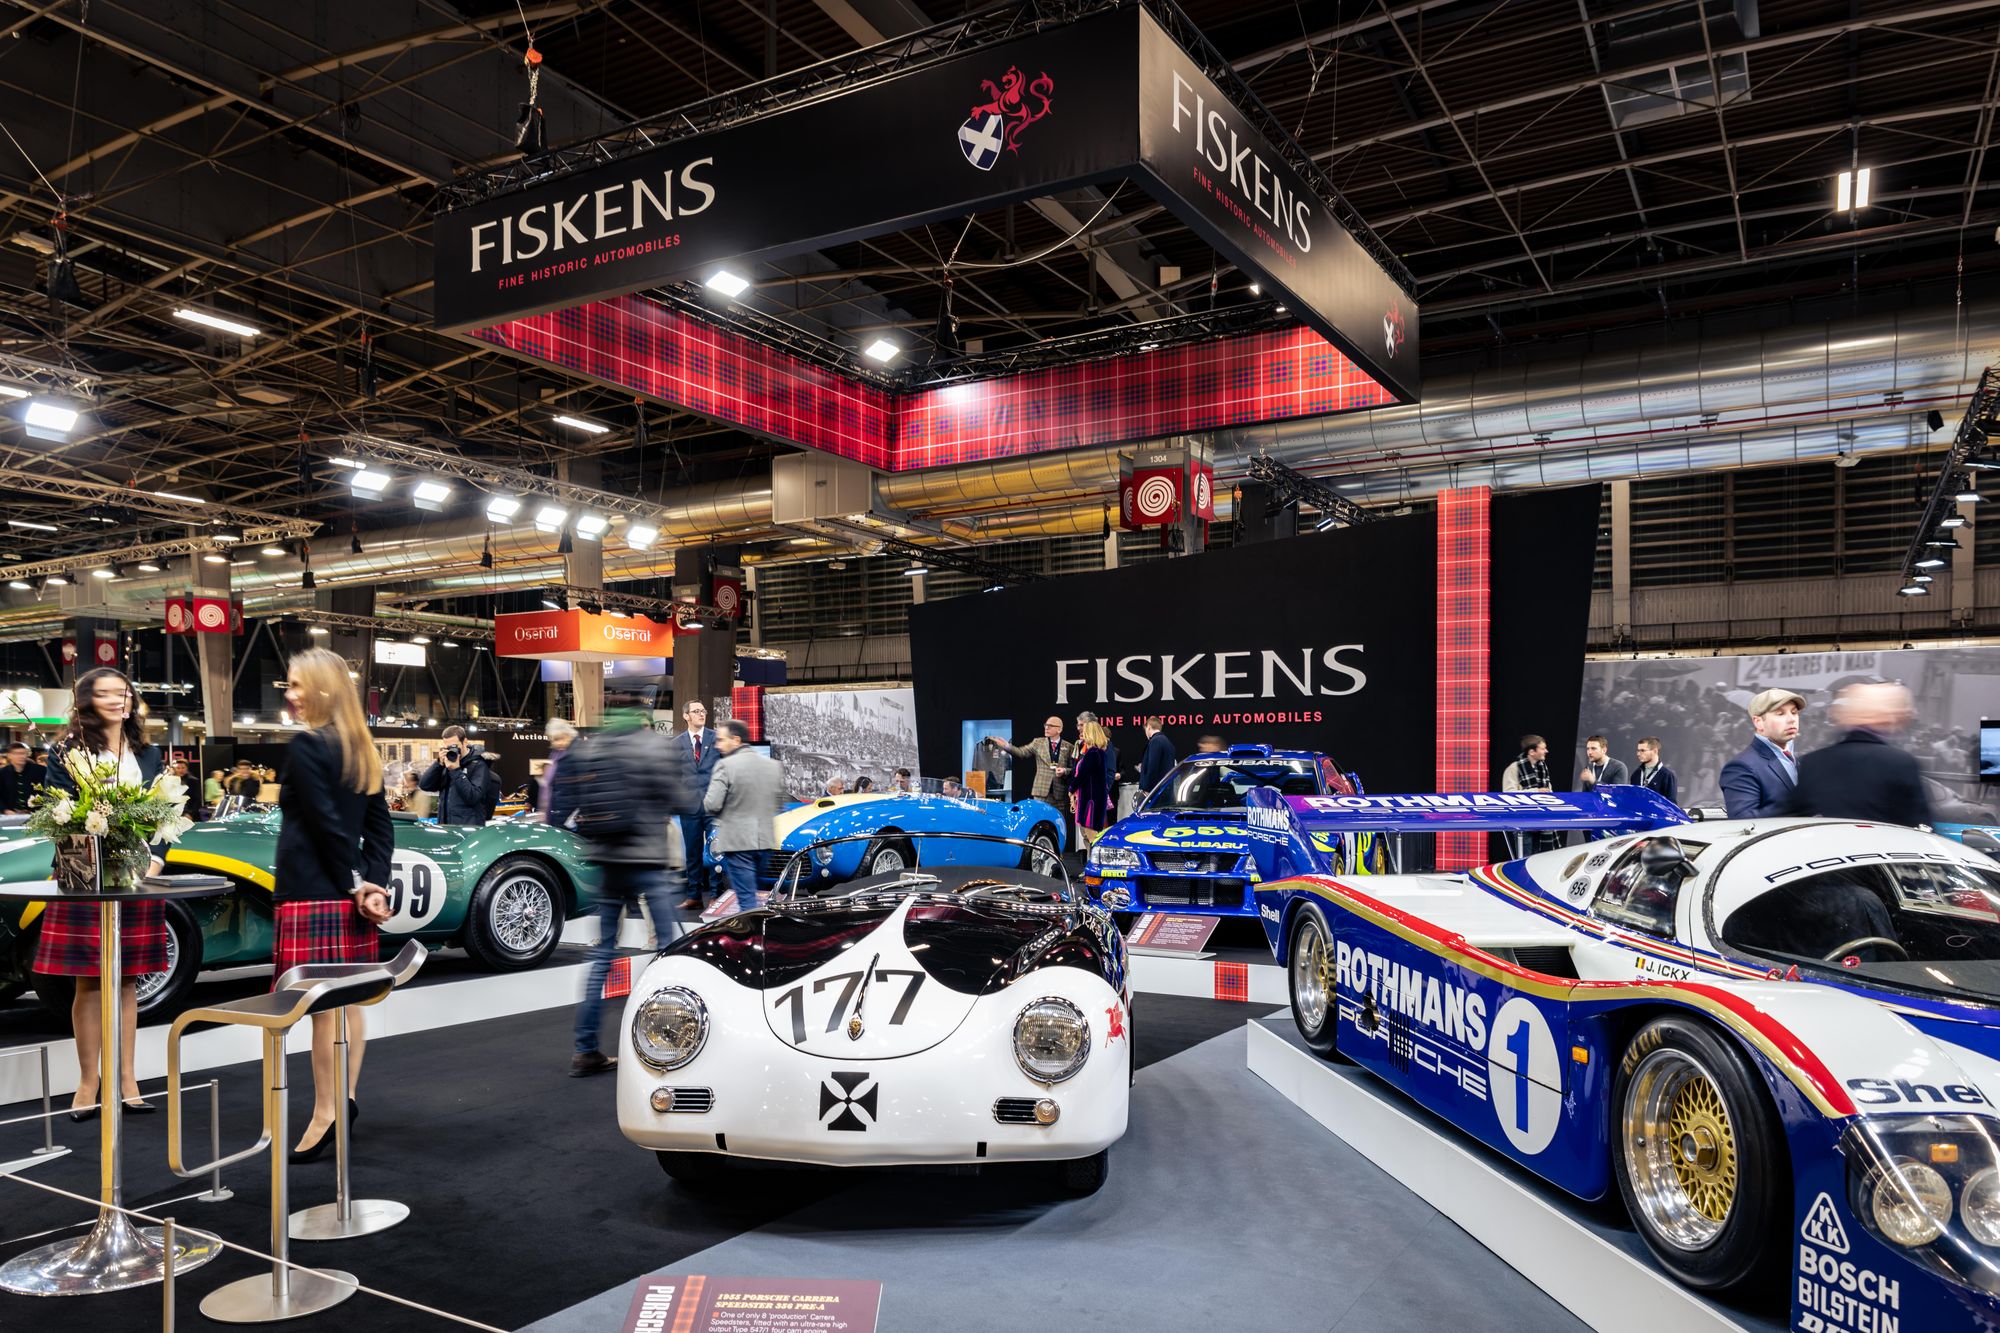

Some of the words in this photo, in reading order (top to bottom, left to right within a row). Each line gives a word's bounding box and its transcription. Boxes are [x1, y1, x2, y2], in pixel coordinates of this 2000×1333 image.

[1172, 69, 1311, 253] FISKENS
[470, 156, 716, 273] FISKENS
[1193, 166, 1212, 192] FINE
[1215, 187, 1251, 228] HISTORIC
[1253, 223, 1297, 269] AUTOMOBILES
[498, 275, 525, 290] FINE
[531, 257, 588, 282] HISTORIC
[593, 234, 681, 265] AUTOMOBILES
[1149, 455, 1167, 463] 1304
[514, 625, 558, 642] Osenat
[603, 624, 652, 642] Osenat
[1055, 644, 1367, 704] FISKENS
[1100, 716, 1124, 727] INE
[1133, 714, 1204, 727] HITORIC
[1212, 711, 1323, 725] AUTOMOBILES
[1303, 794, 1566, 808] ROTHMANS
[1247, 806, 1290, 831] ROTHMANS
[1180, 841, 1249, 850] SUBARU
[1247, 831, 1289, 846] PORSCHE
[1589, 855, 1609, 867] 956
[1569, 881, 1588, 897] 956
[1260, 903, 1280, 924] Shell
[1336, 940, 1487, 1051] ROTHMANS
[774, 969, 927, 1046] 177
[1338, 1003, 1487, 1101] PORSCHE
[1622, 1025, 1663, 1076] AVON
[1506, 1019, 1530, 1134] 1
[1799, 1243, 1900, 1311] BOSCH
[714, 1301, 774, 1309] SPEEDSTER
[794, 1302, 825, 1311] PRE-A
[742, 1293, 791, 1302] PORSCHE
[791, 1295, 840, 1303] CARRERA
[1798, 1275, 1900, 1333] BILSTEIN
[720, 1311, 736, 1319] One
[736, 1311, 745, 1319] of
[745, 1312, 761, 1321] only
[810, 1313, 835, 1321] Carrera
[753, 1319, 772, 1327] fitted
[800, 1320, 831, 1328] ultra-rare
[832, 1321, 848, 1330] high
